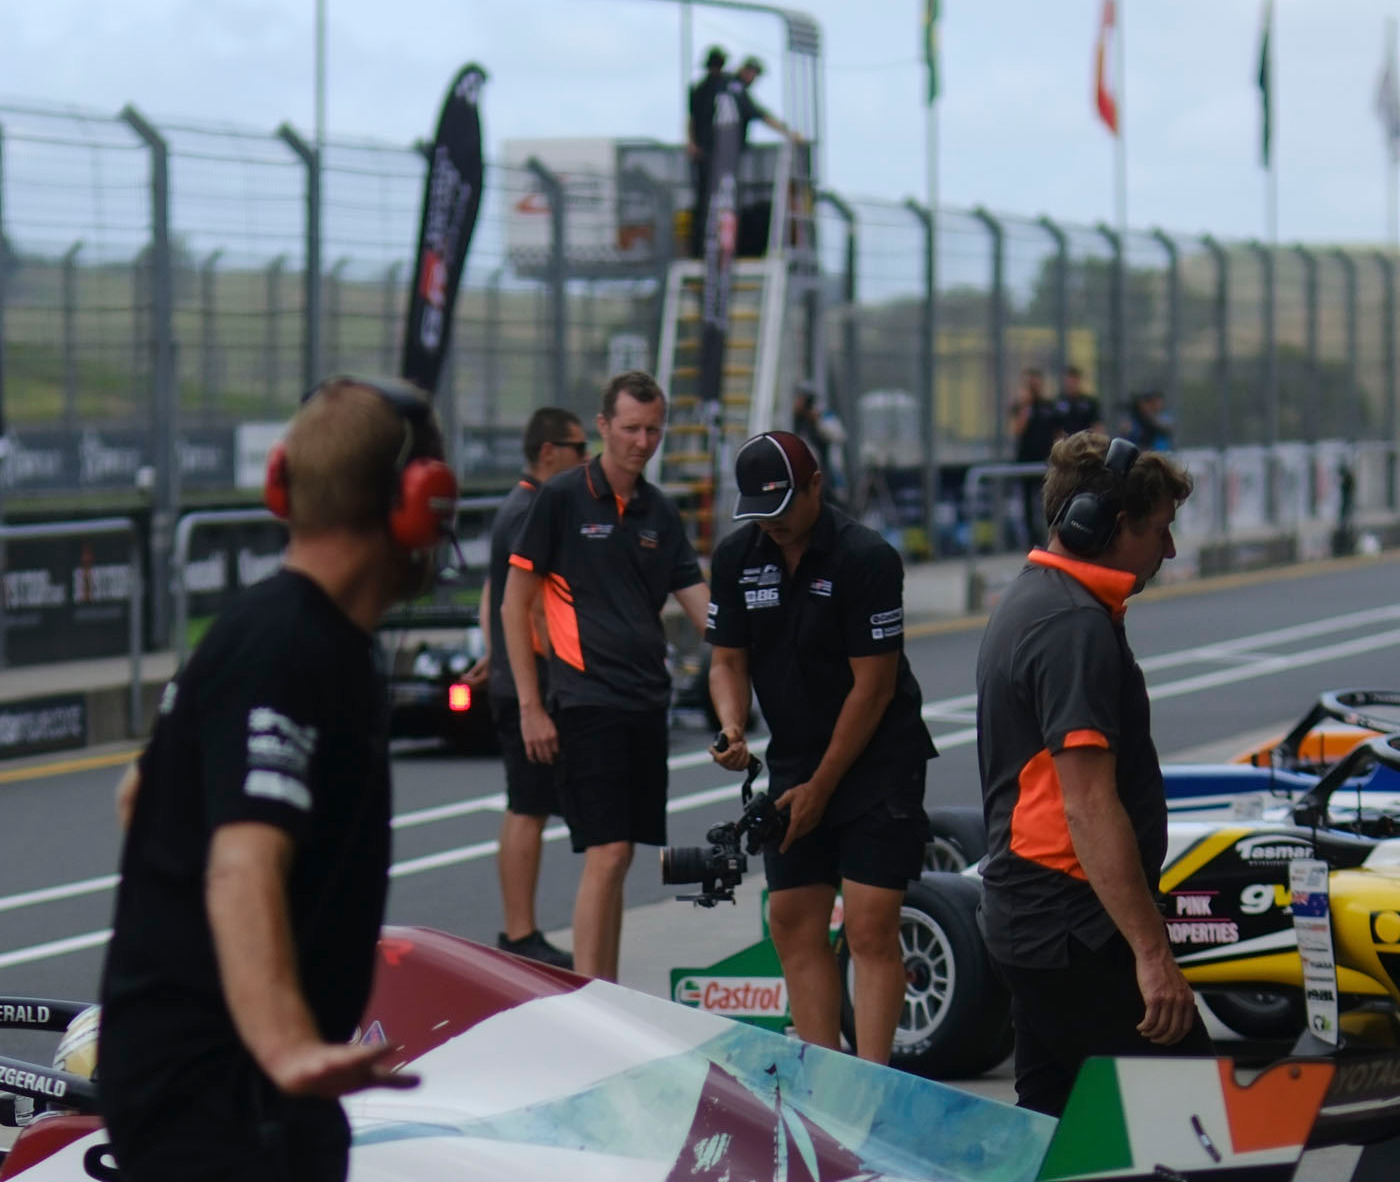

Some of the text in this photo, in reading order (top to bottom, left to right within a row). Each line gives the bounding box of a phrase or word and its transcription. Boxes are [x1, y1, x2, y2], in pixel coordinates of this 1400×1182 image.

[1176, 895, 1212, 916] PINK
[1167, 922, 1240, 944] OPERTIES
[704, 981, 782, 1011] Castrol
